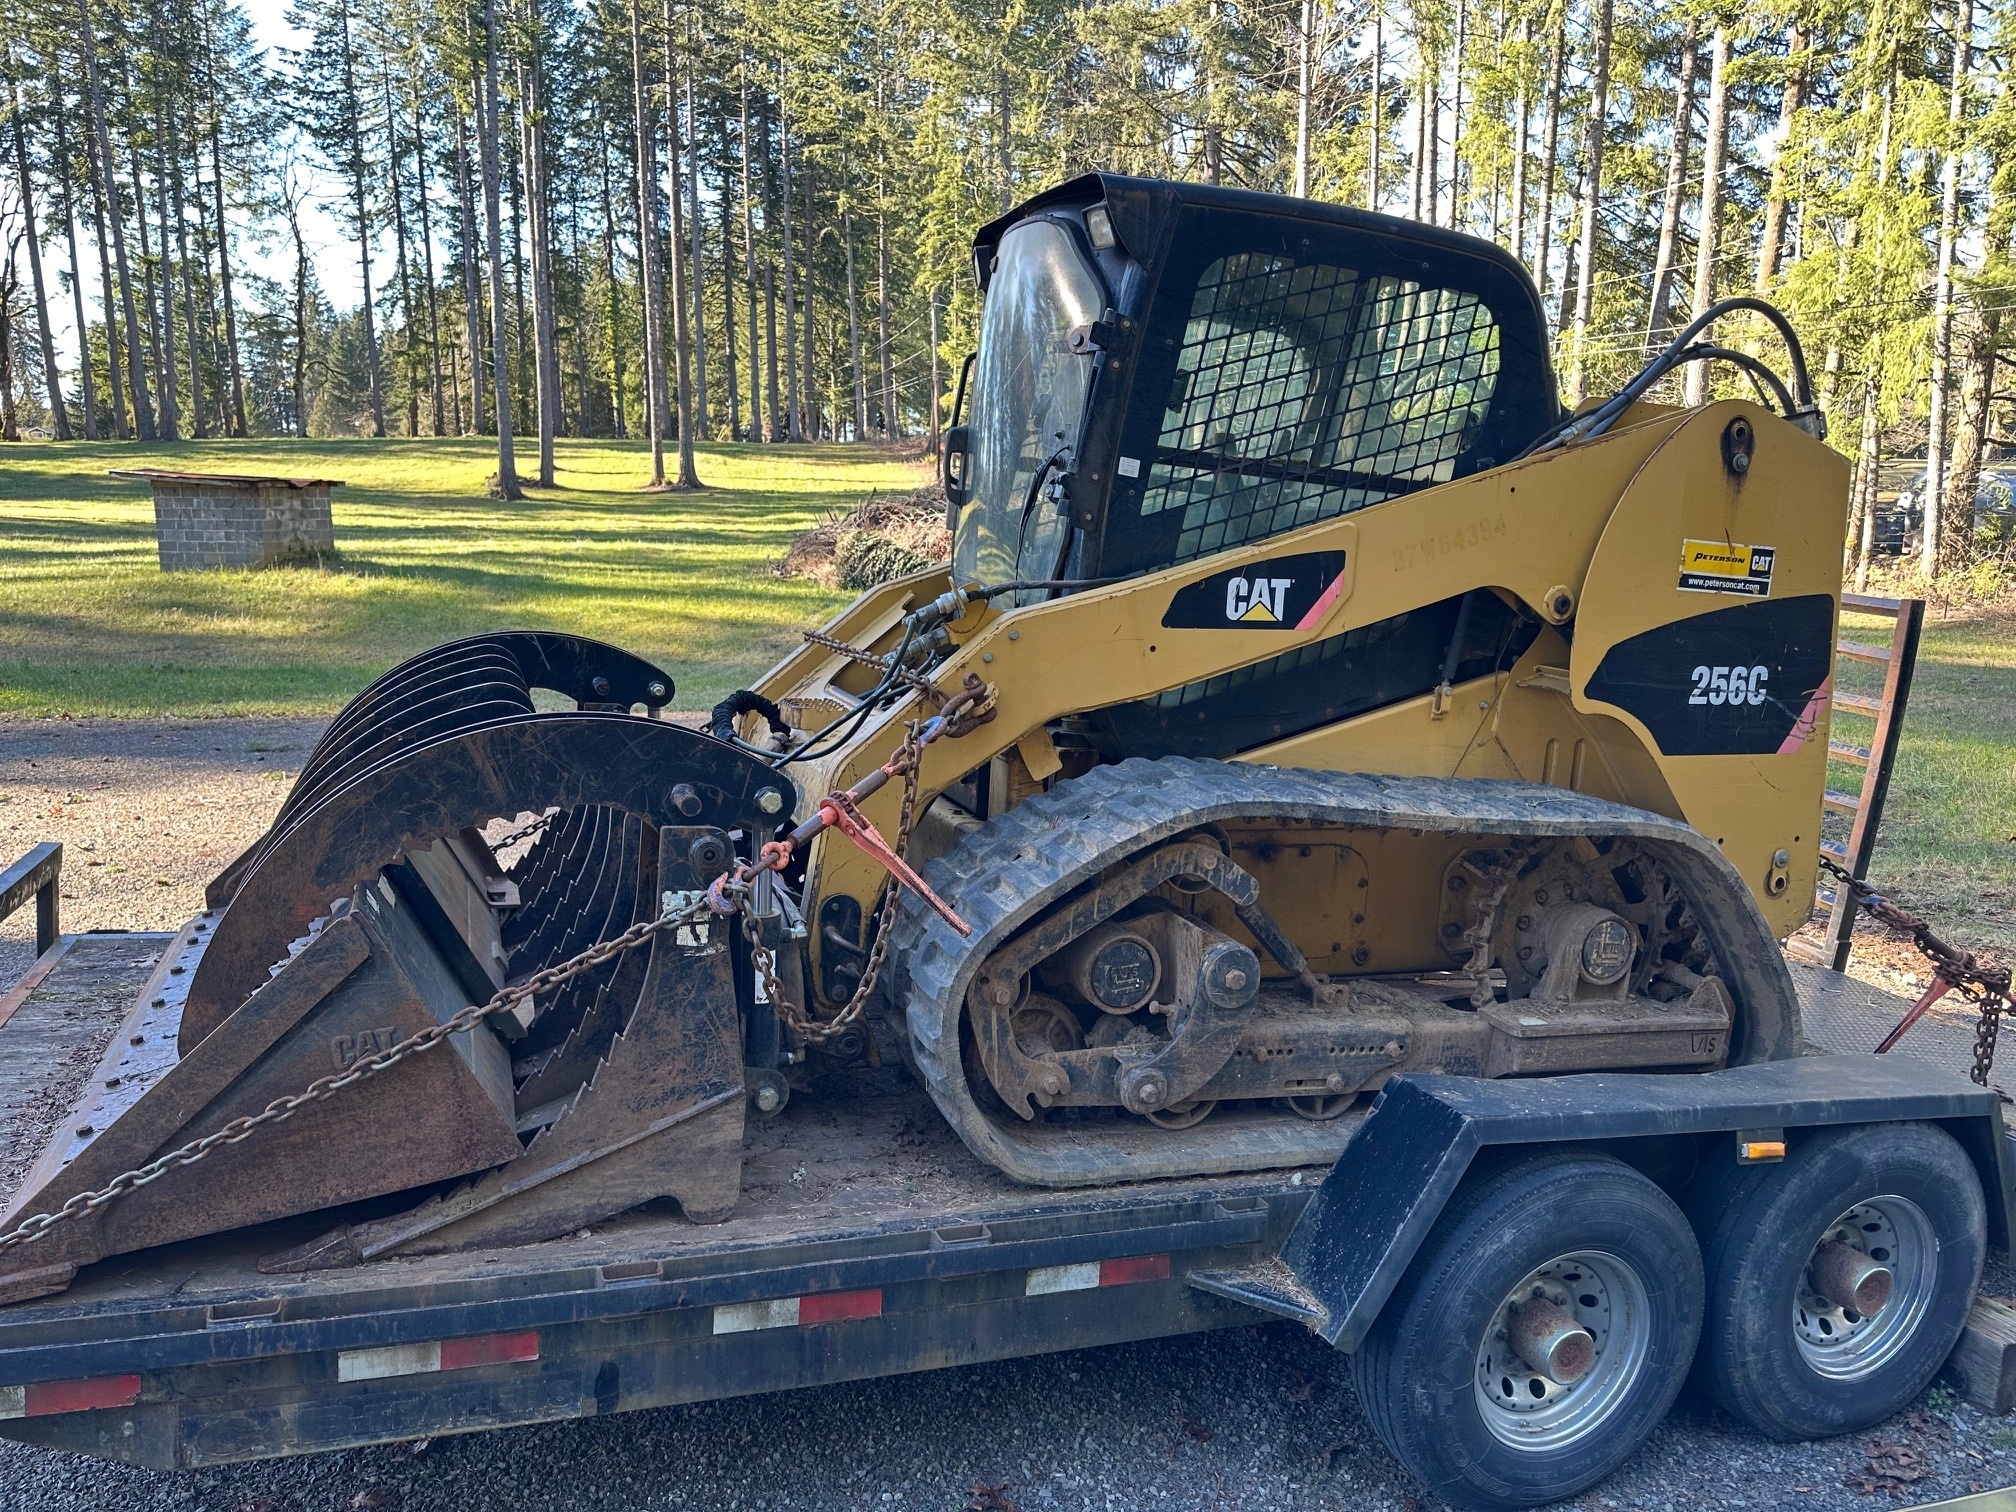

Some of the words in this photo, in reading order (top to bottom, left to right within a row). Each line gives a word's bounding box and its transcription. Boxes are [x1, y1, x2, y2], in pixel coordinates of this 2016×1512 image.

[1693, 552, 1746, 564] PETERSON
[1751, 555, 1773, 572] CAT
[1226, 576, 1291, 622] CAT
[1688, 577, 1760, 591] www.petersoncat.com
[1688, 665, 1769, 706] 256C
[332, 1026, 395, 1071] CAT
